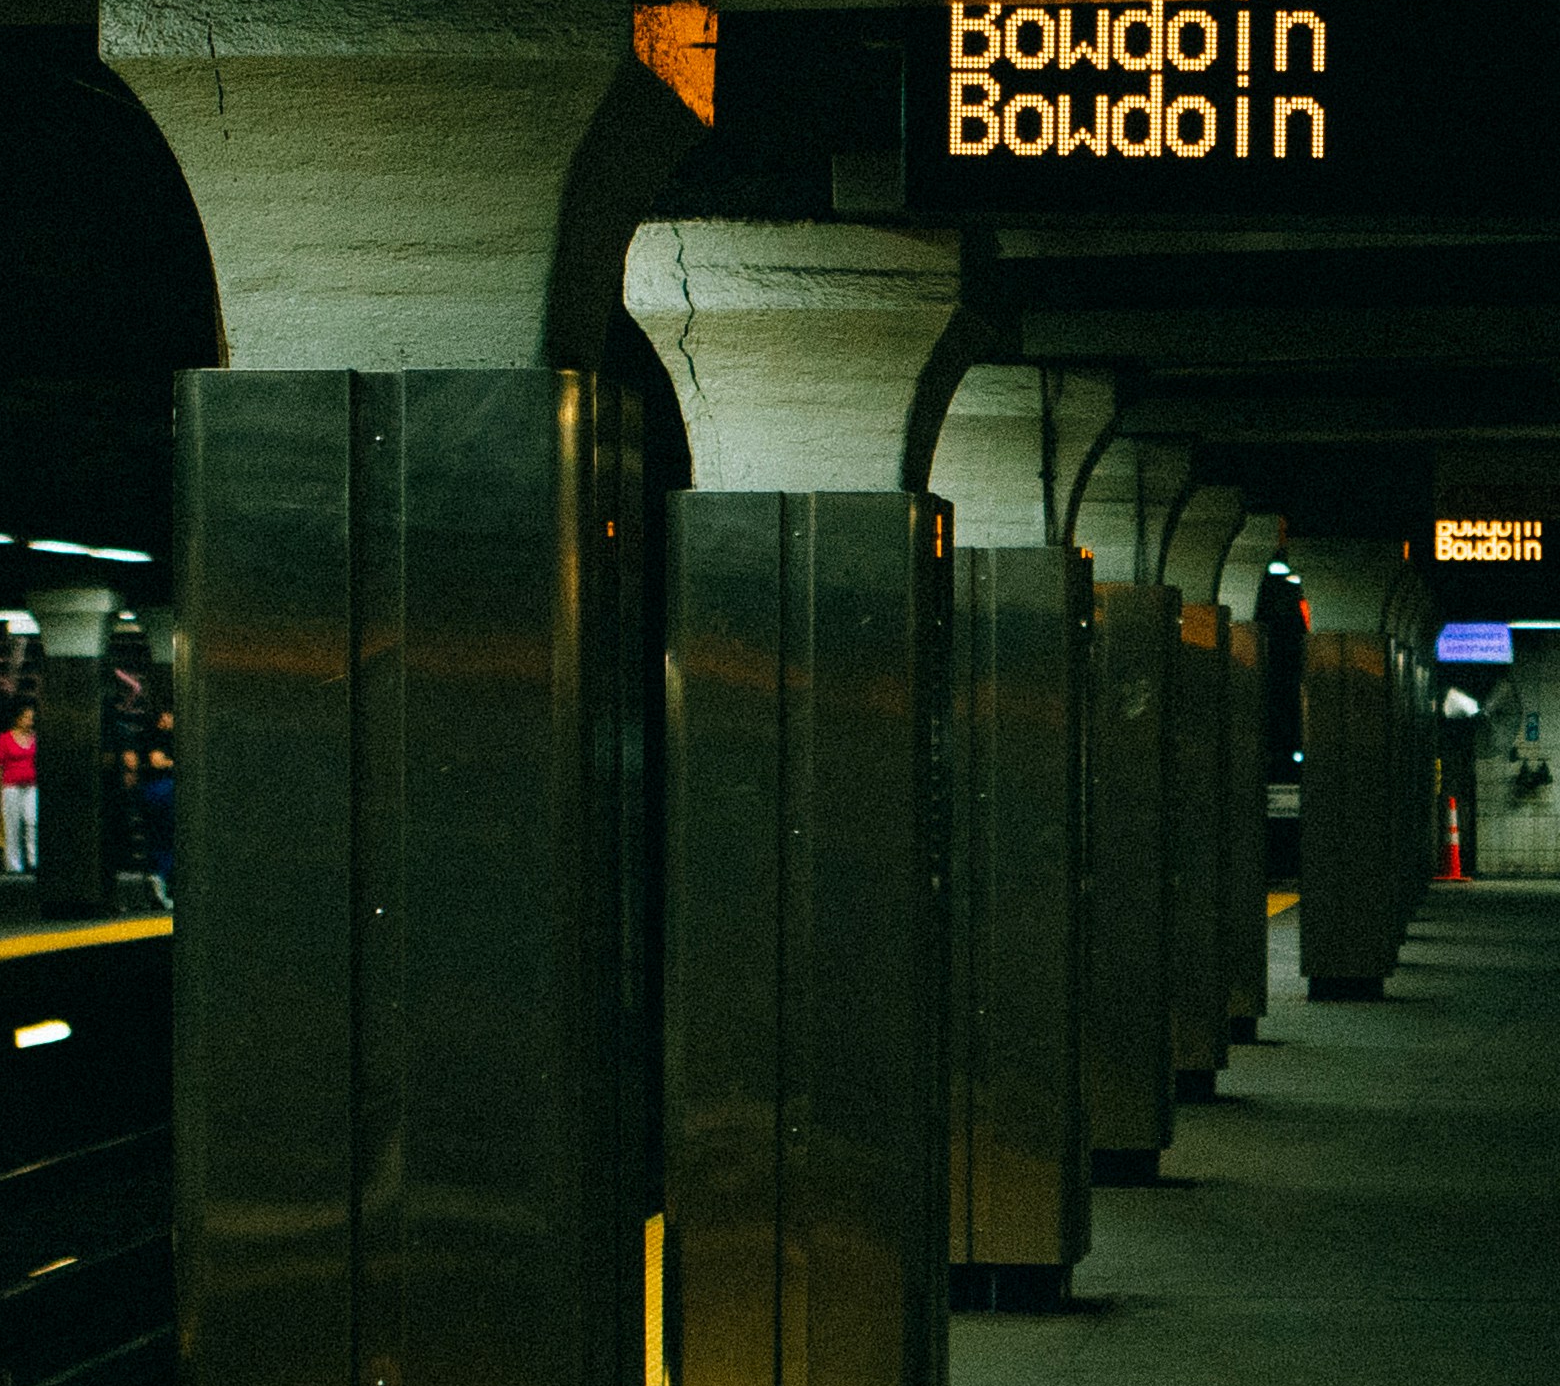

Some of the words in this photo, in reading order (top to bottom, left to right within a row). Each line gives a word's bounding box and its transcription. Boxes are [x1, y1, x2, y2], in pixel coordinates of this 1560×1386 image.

[949, 0, 1326, 72] Bowdoin
[949, 72, 1326, 159] Bowdoin
[1435, 536, 1542, 561] Bowdoin
